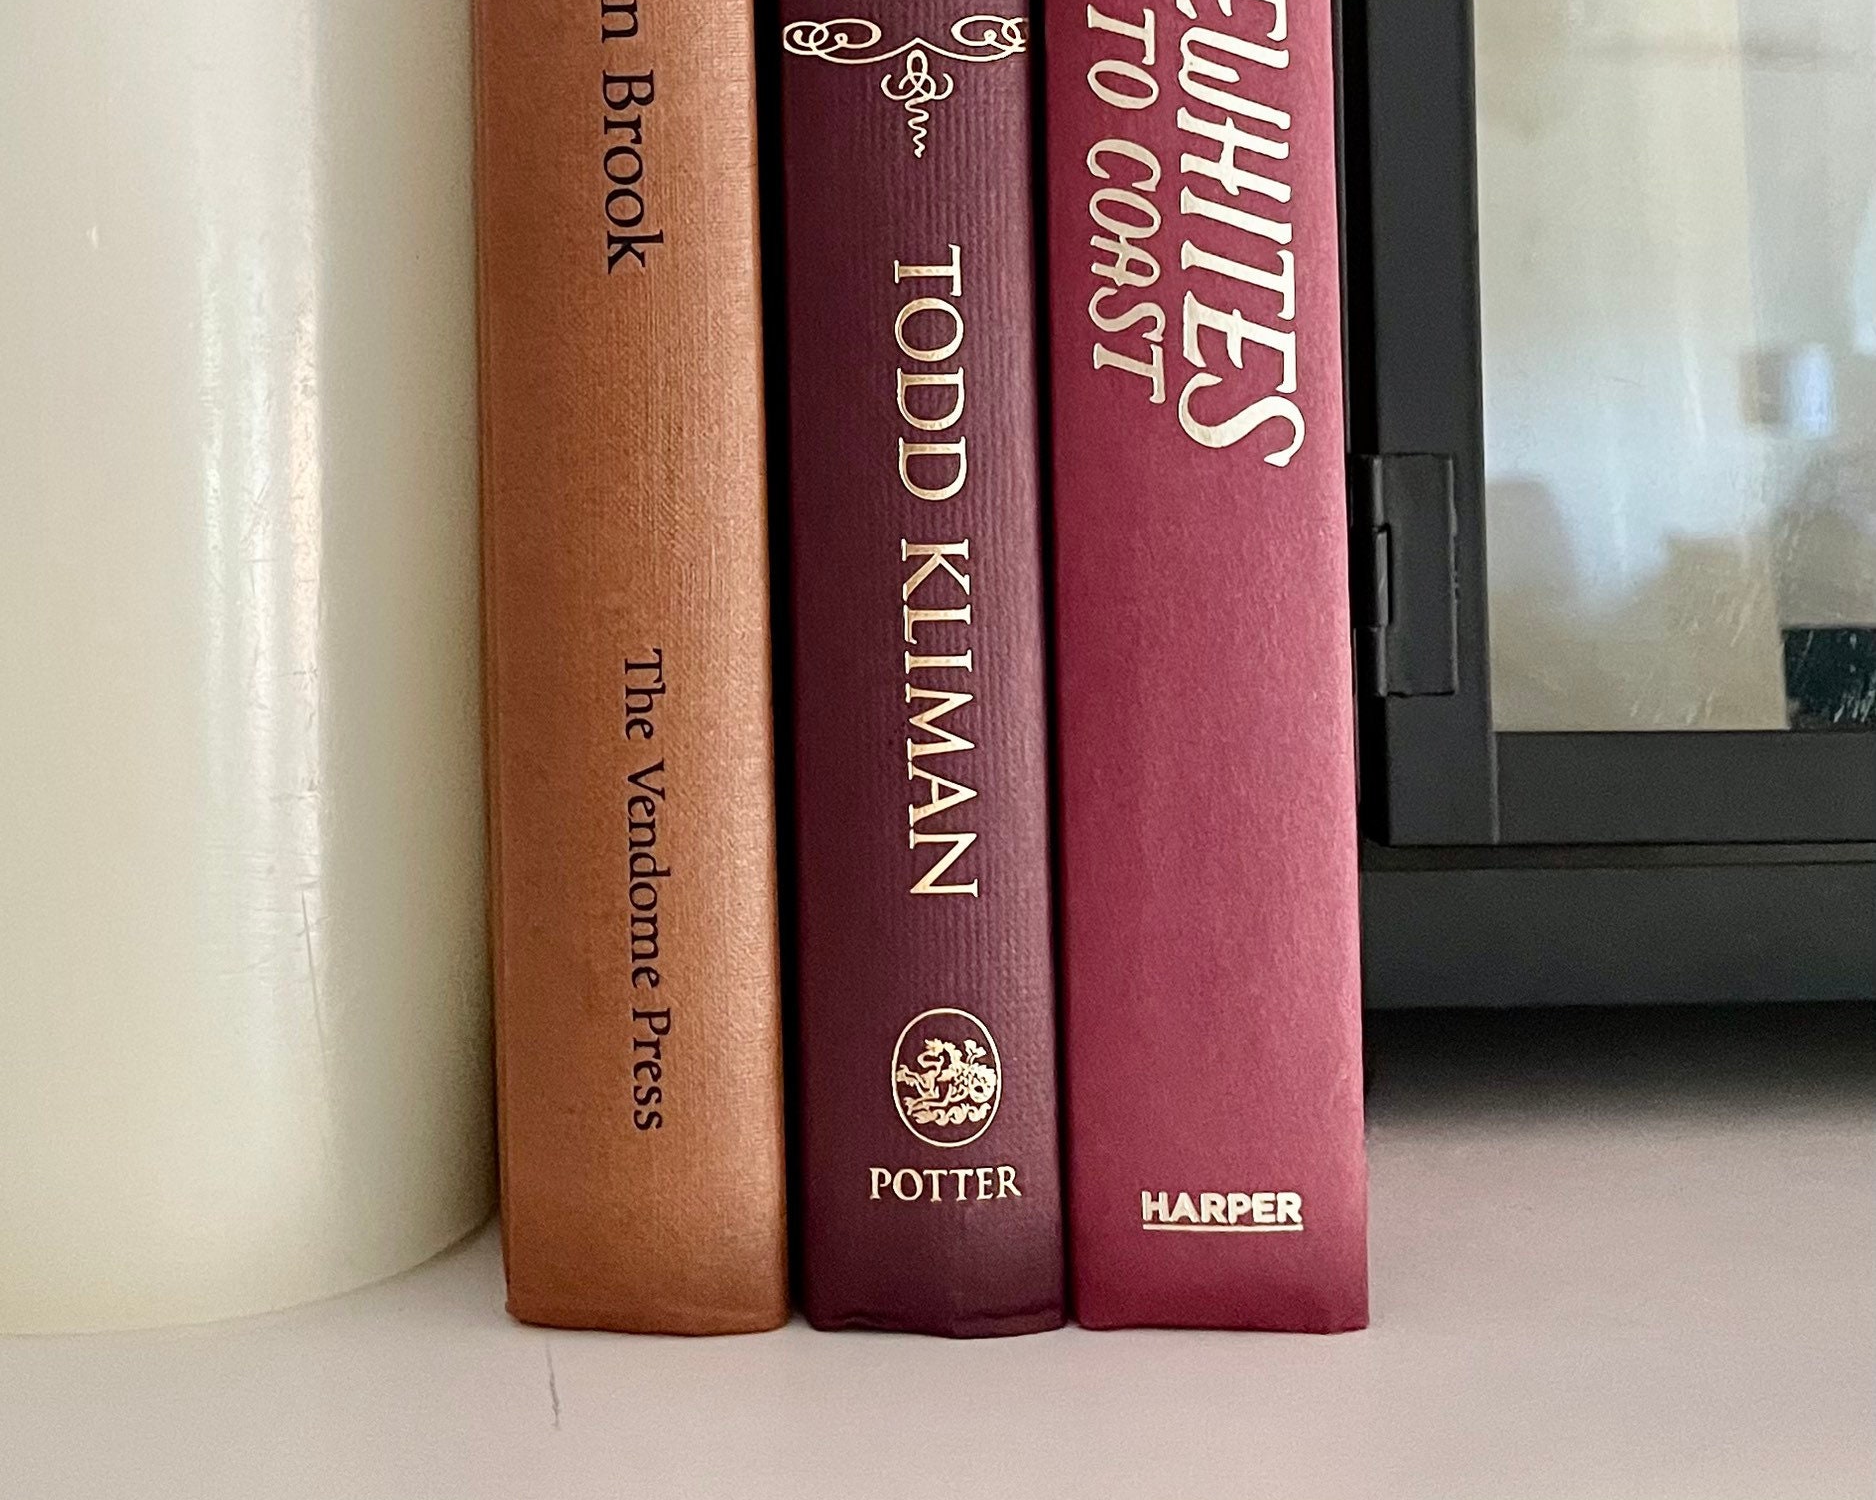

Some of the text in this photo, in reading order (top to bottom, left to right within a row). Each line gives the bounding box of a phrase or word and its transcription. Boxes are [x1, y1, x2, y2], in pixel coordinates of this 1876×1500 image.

[1086, 3, 1160, 110] TO
[602, 69, 664, 275] Brook
[1086, 138, 1166, 404] COAST
[893, 243, 979, 898] TODD KLIMAN
[624, 647, 672, 1131] The Vendome Press
[869, 1165, 1022, 1203] POTTER
[1141, 1191, 1303, 1224] HARPER
